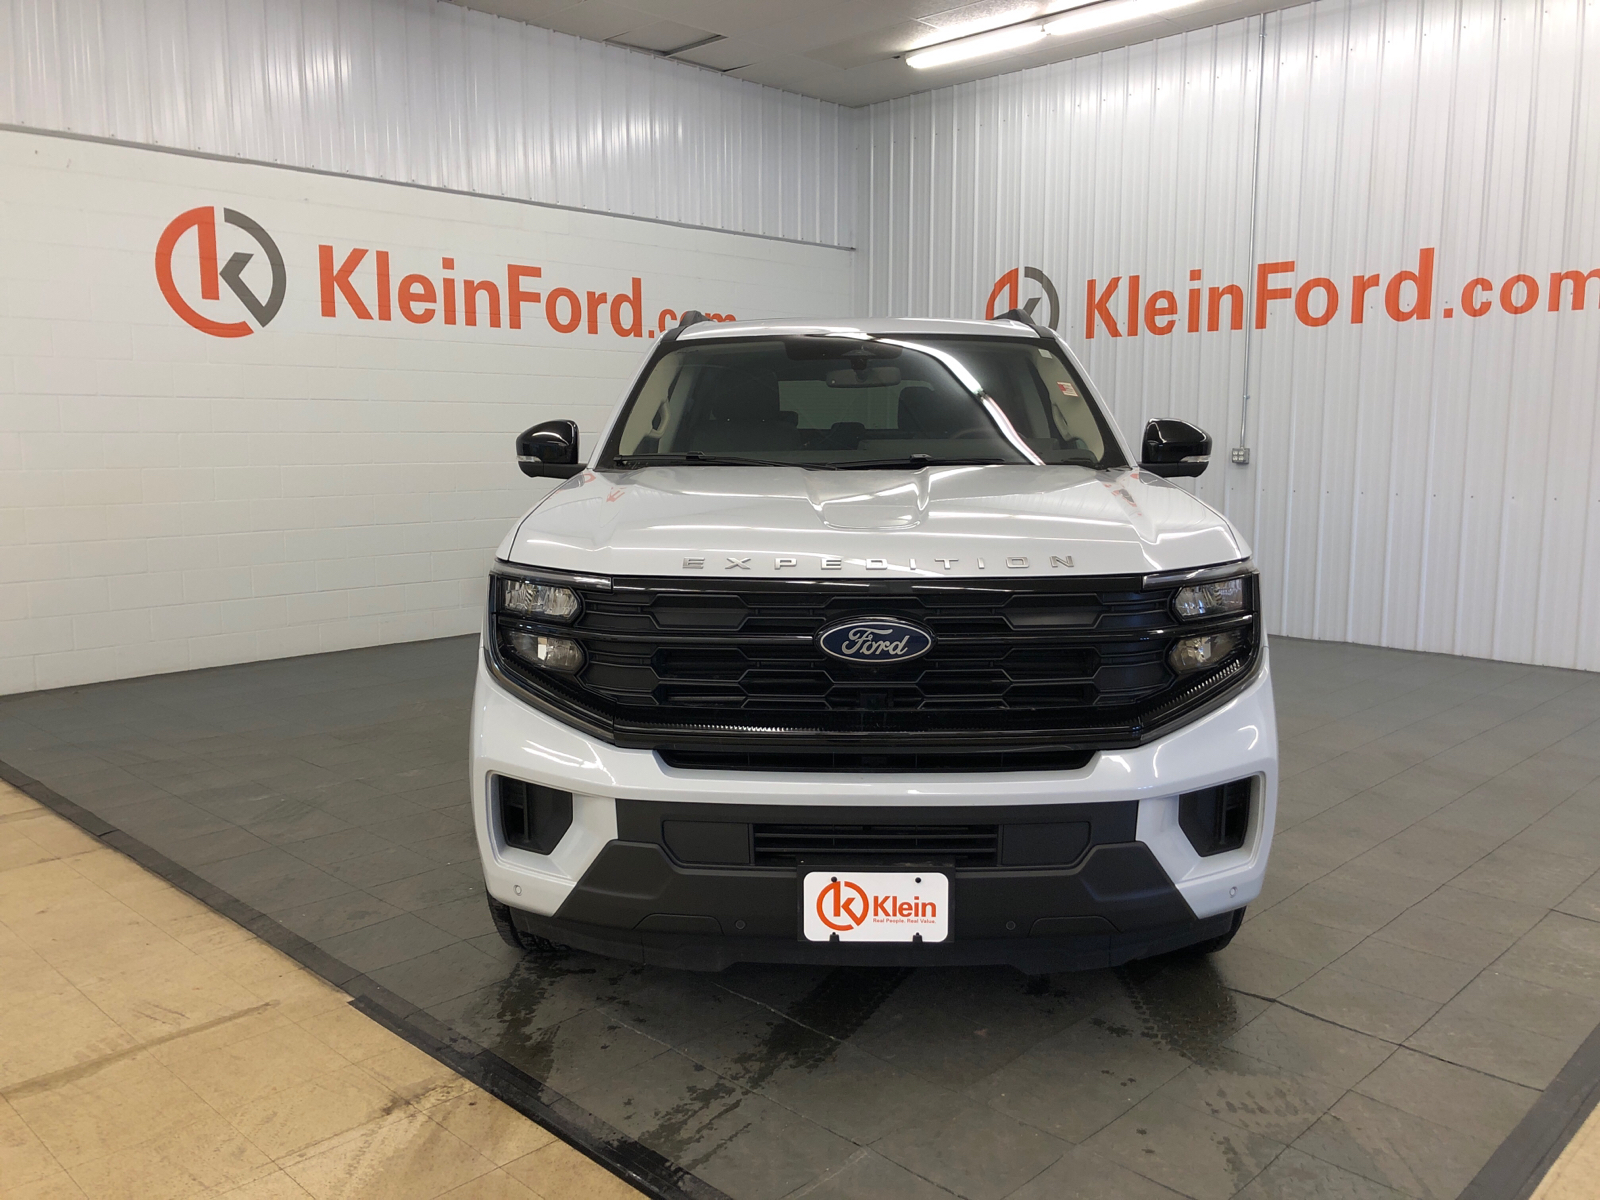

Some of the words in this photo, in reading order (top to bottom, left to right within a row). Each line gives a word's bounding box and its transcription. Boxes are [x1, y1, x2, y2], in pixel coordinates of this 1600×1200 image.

[319, 245, 735, 338] KleinFord.c
[1086, 248, 1600, 339] KleinFord.com
[682, 555, 1075, 571] EXPEDITION
[842, 627, 908, 655] Ford
[873, 896, 936, 917] Klein
